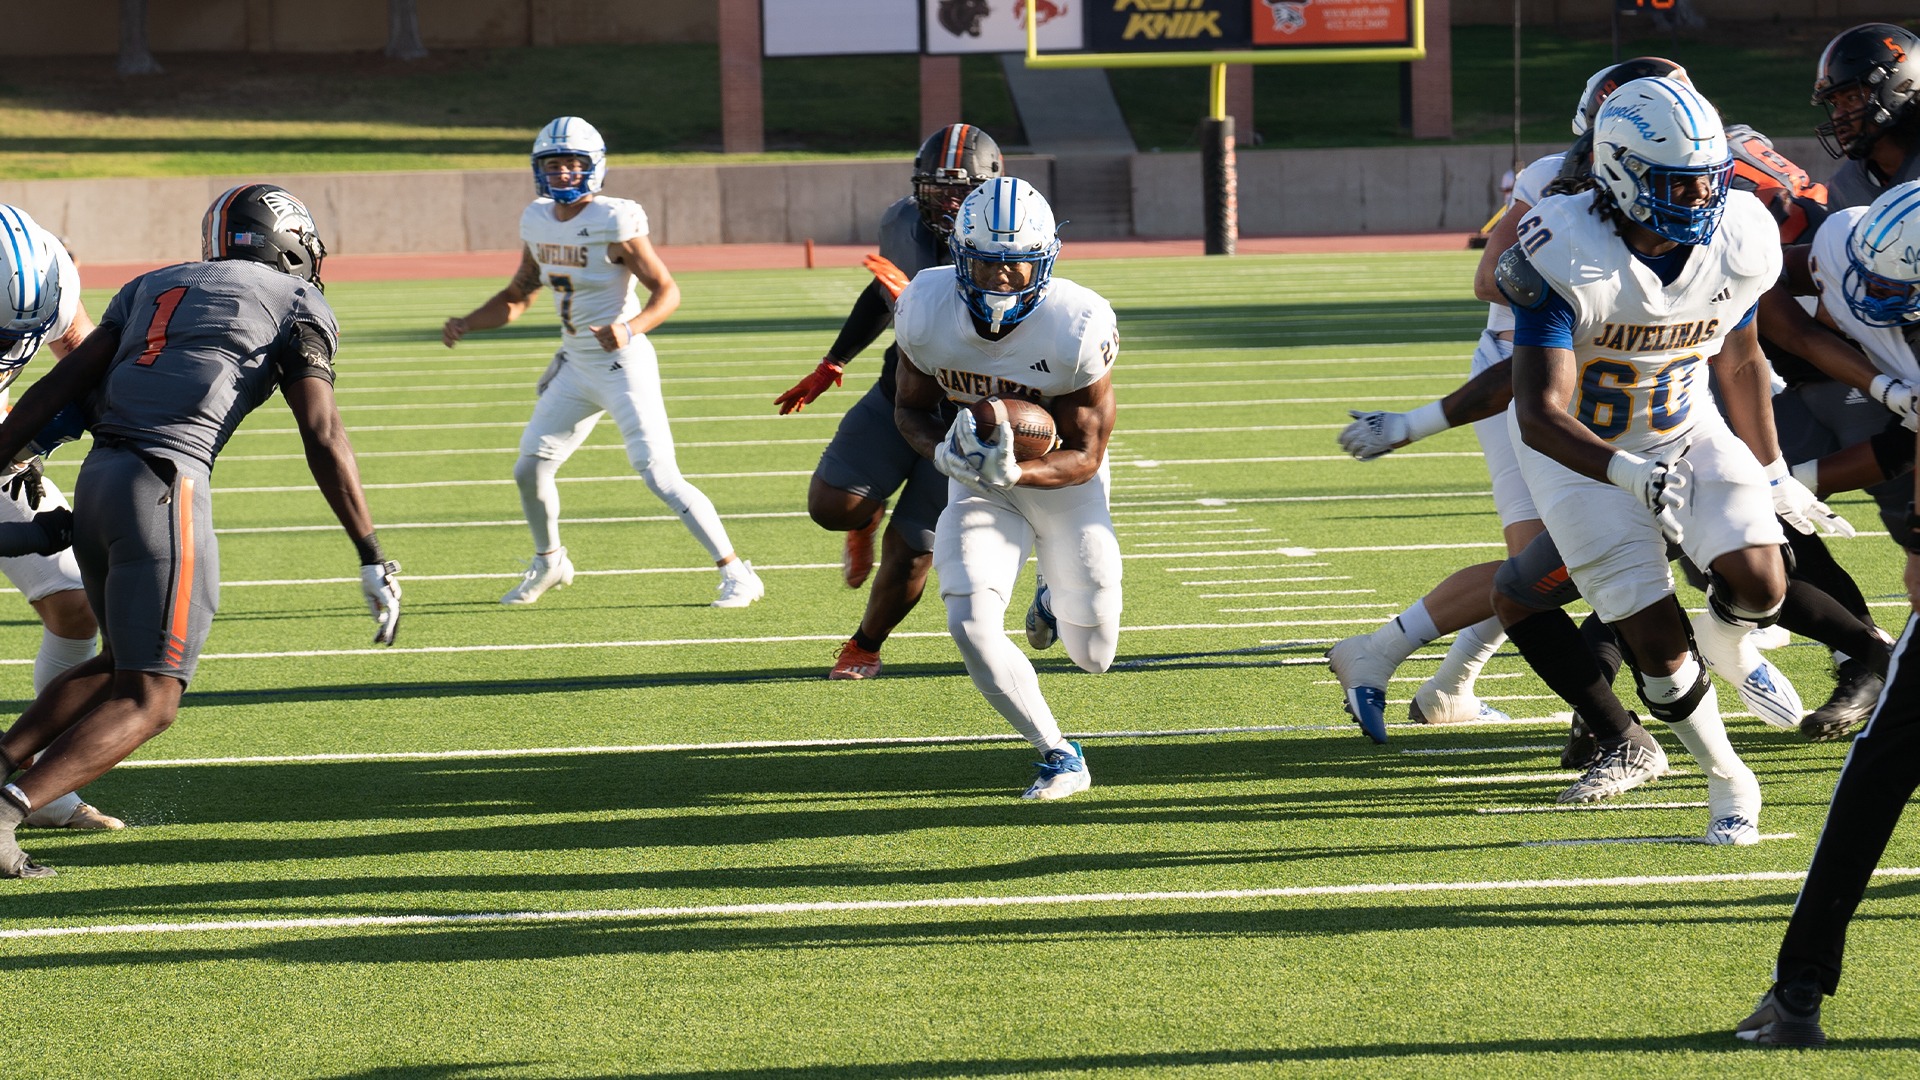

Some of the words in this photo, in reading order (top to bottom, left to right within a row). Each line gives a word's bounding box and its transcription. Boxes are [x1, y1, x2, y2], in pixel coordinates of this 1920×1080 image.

[1882, 36, 1907, 63] 5
[133, 286, 191, 367] 1
[547, 272, 578, 337] 7
[1593, 318, 1720, 352] JAVELINAS
[1574, 351, 1704, 442] 60
